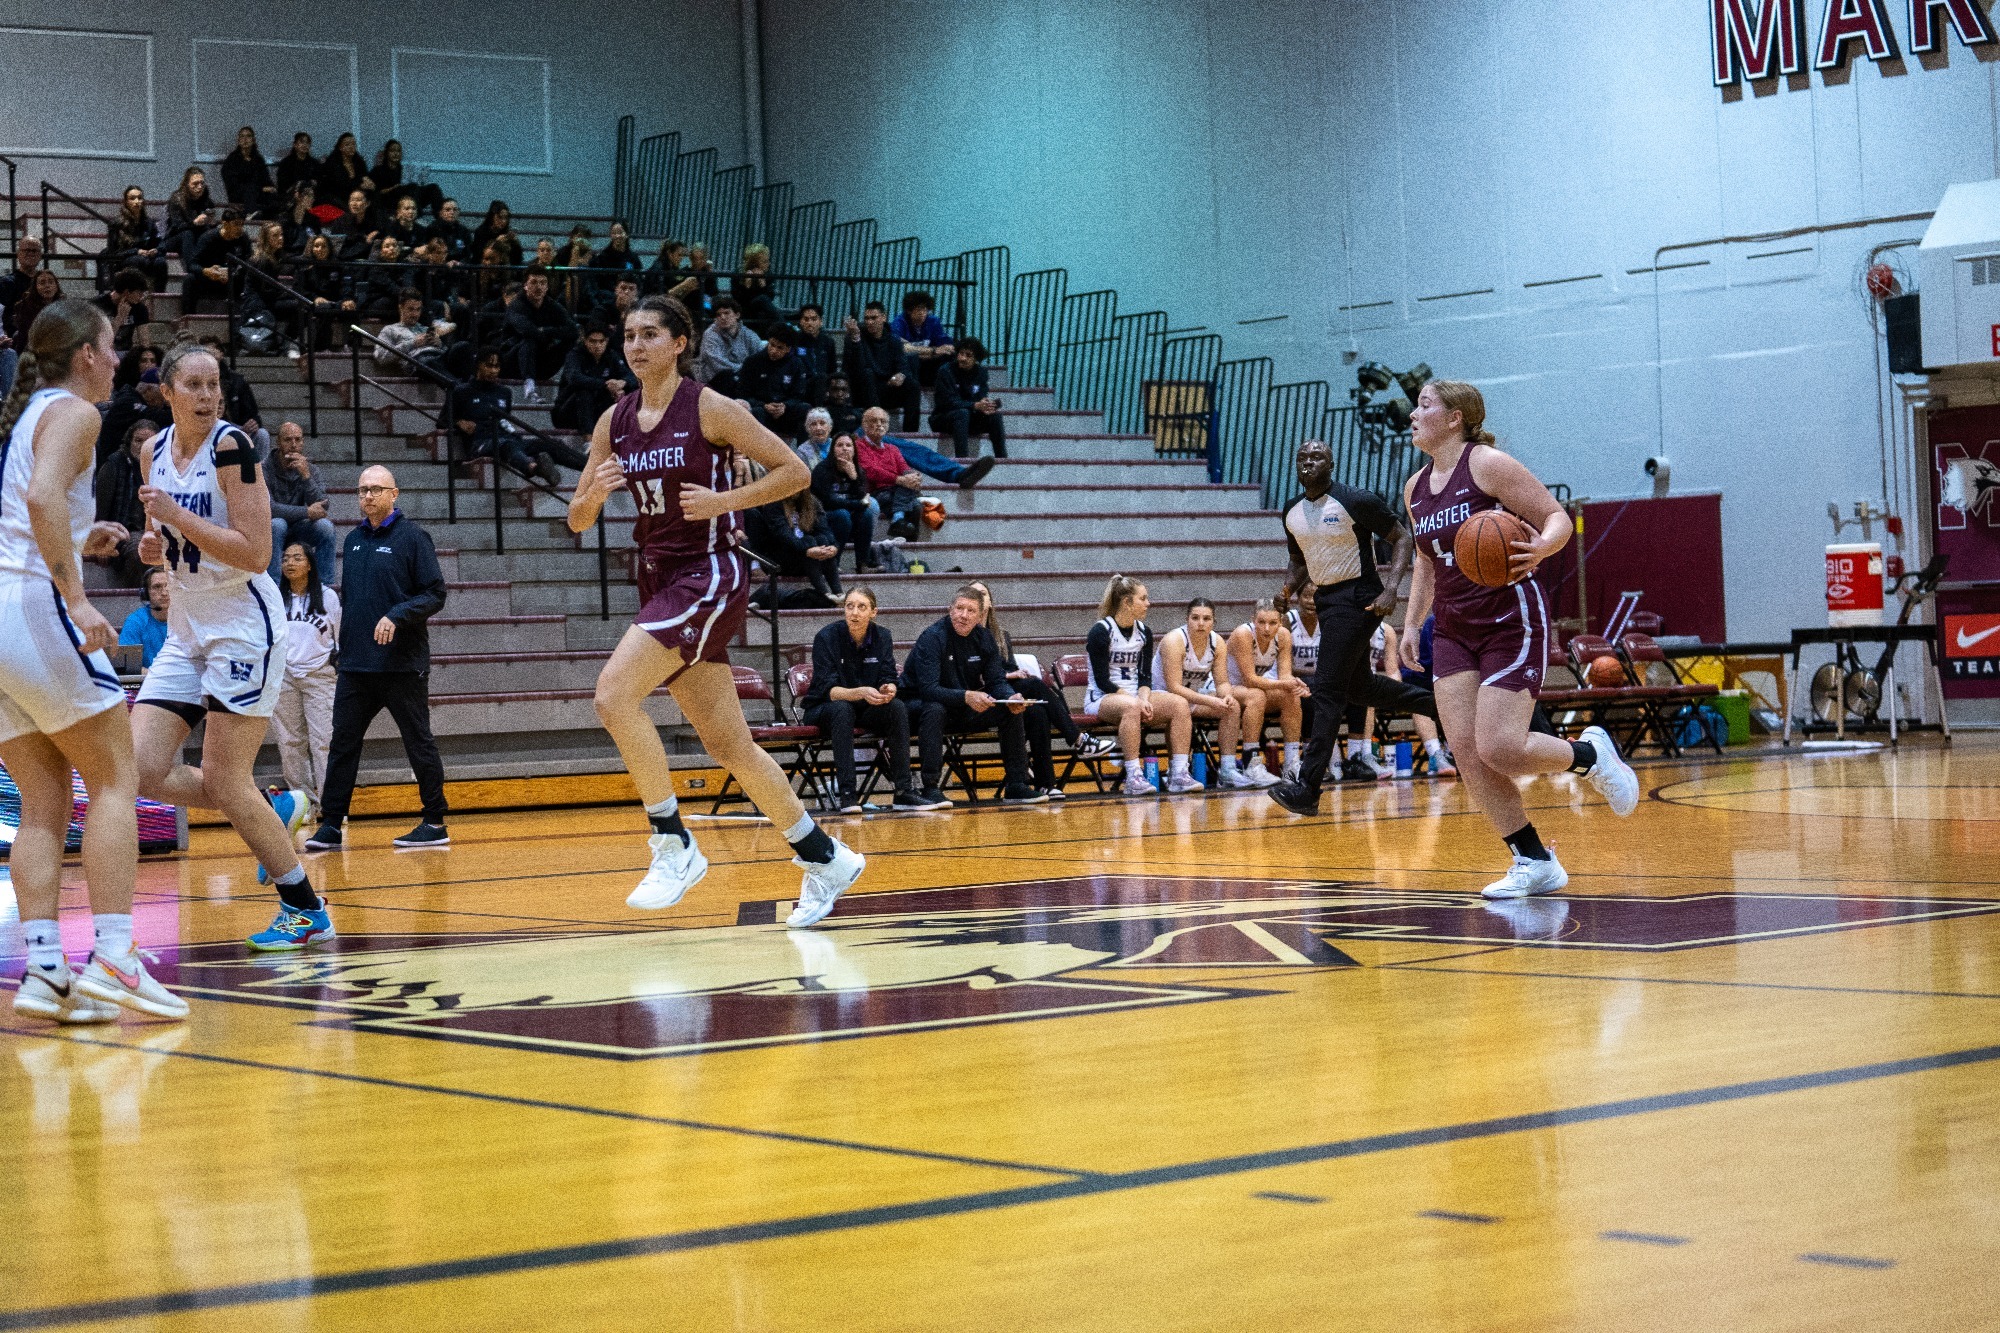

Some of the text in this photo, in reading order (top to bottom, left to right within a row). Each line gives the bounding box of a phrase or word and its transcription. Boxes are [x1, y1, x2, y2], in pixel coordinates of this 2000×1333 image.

[168, 491, 213, 518] TERN
[635, 478, 666, 516] 13
[1415, 502, 1471, 536] cMASTER
[1431, 538, 1455, 567] 4
[1953, 660, 2000, 675] TEA
